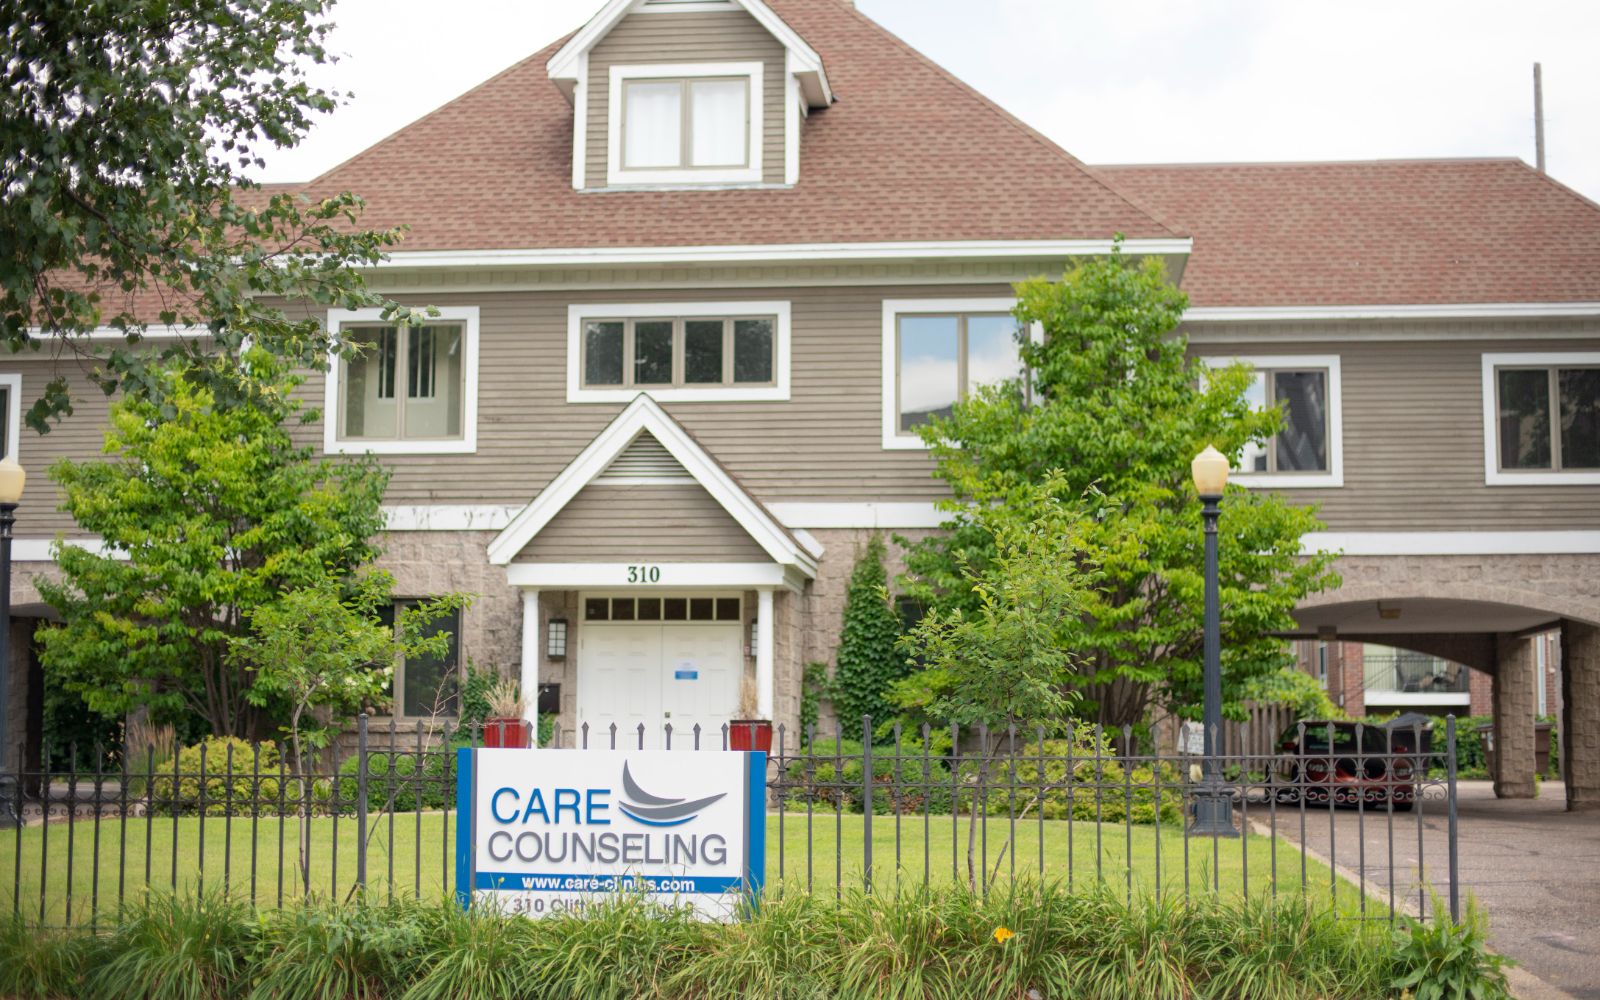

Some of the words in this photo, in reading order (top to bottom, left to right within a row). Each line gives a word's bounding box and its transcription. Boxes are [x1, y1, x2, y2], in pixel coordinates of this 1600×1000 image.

[627, 565, 661, 583] 310
[491, 787, 611, 825] CARE
[488, 830, 727, 866] COUNSELING
[522, 876, 695, 892] www.care-clnics.com
[513, 898, 544, 913] 310
